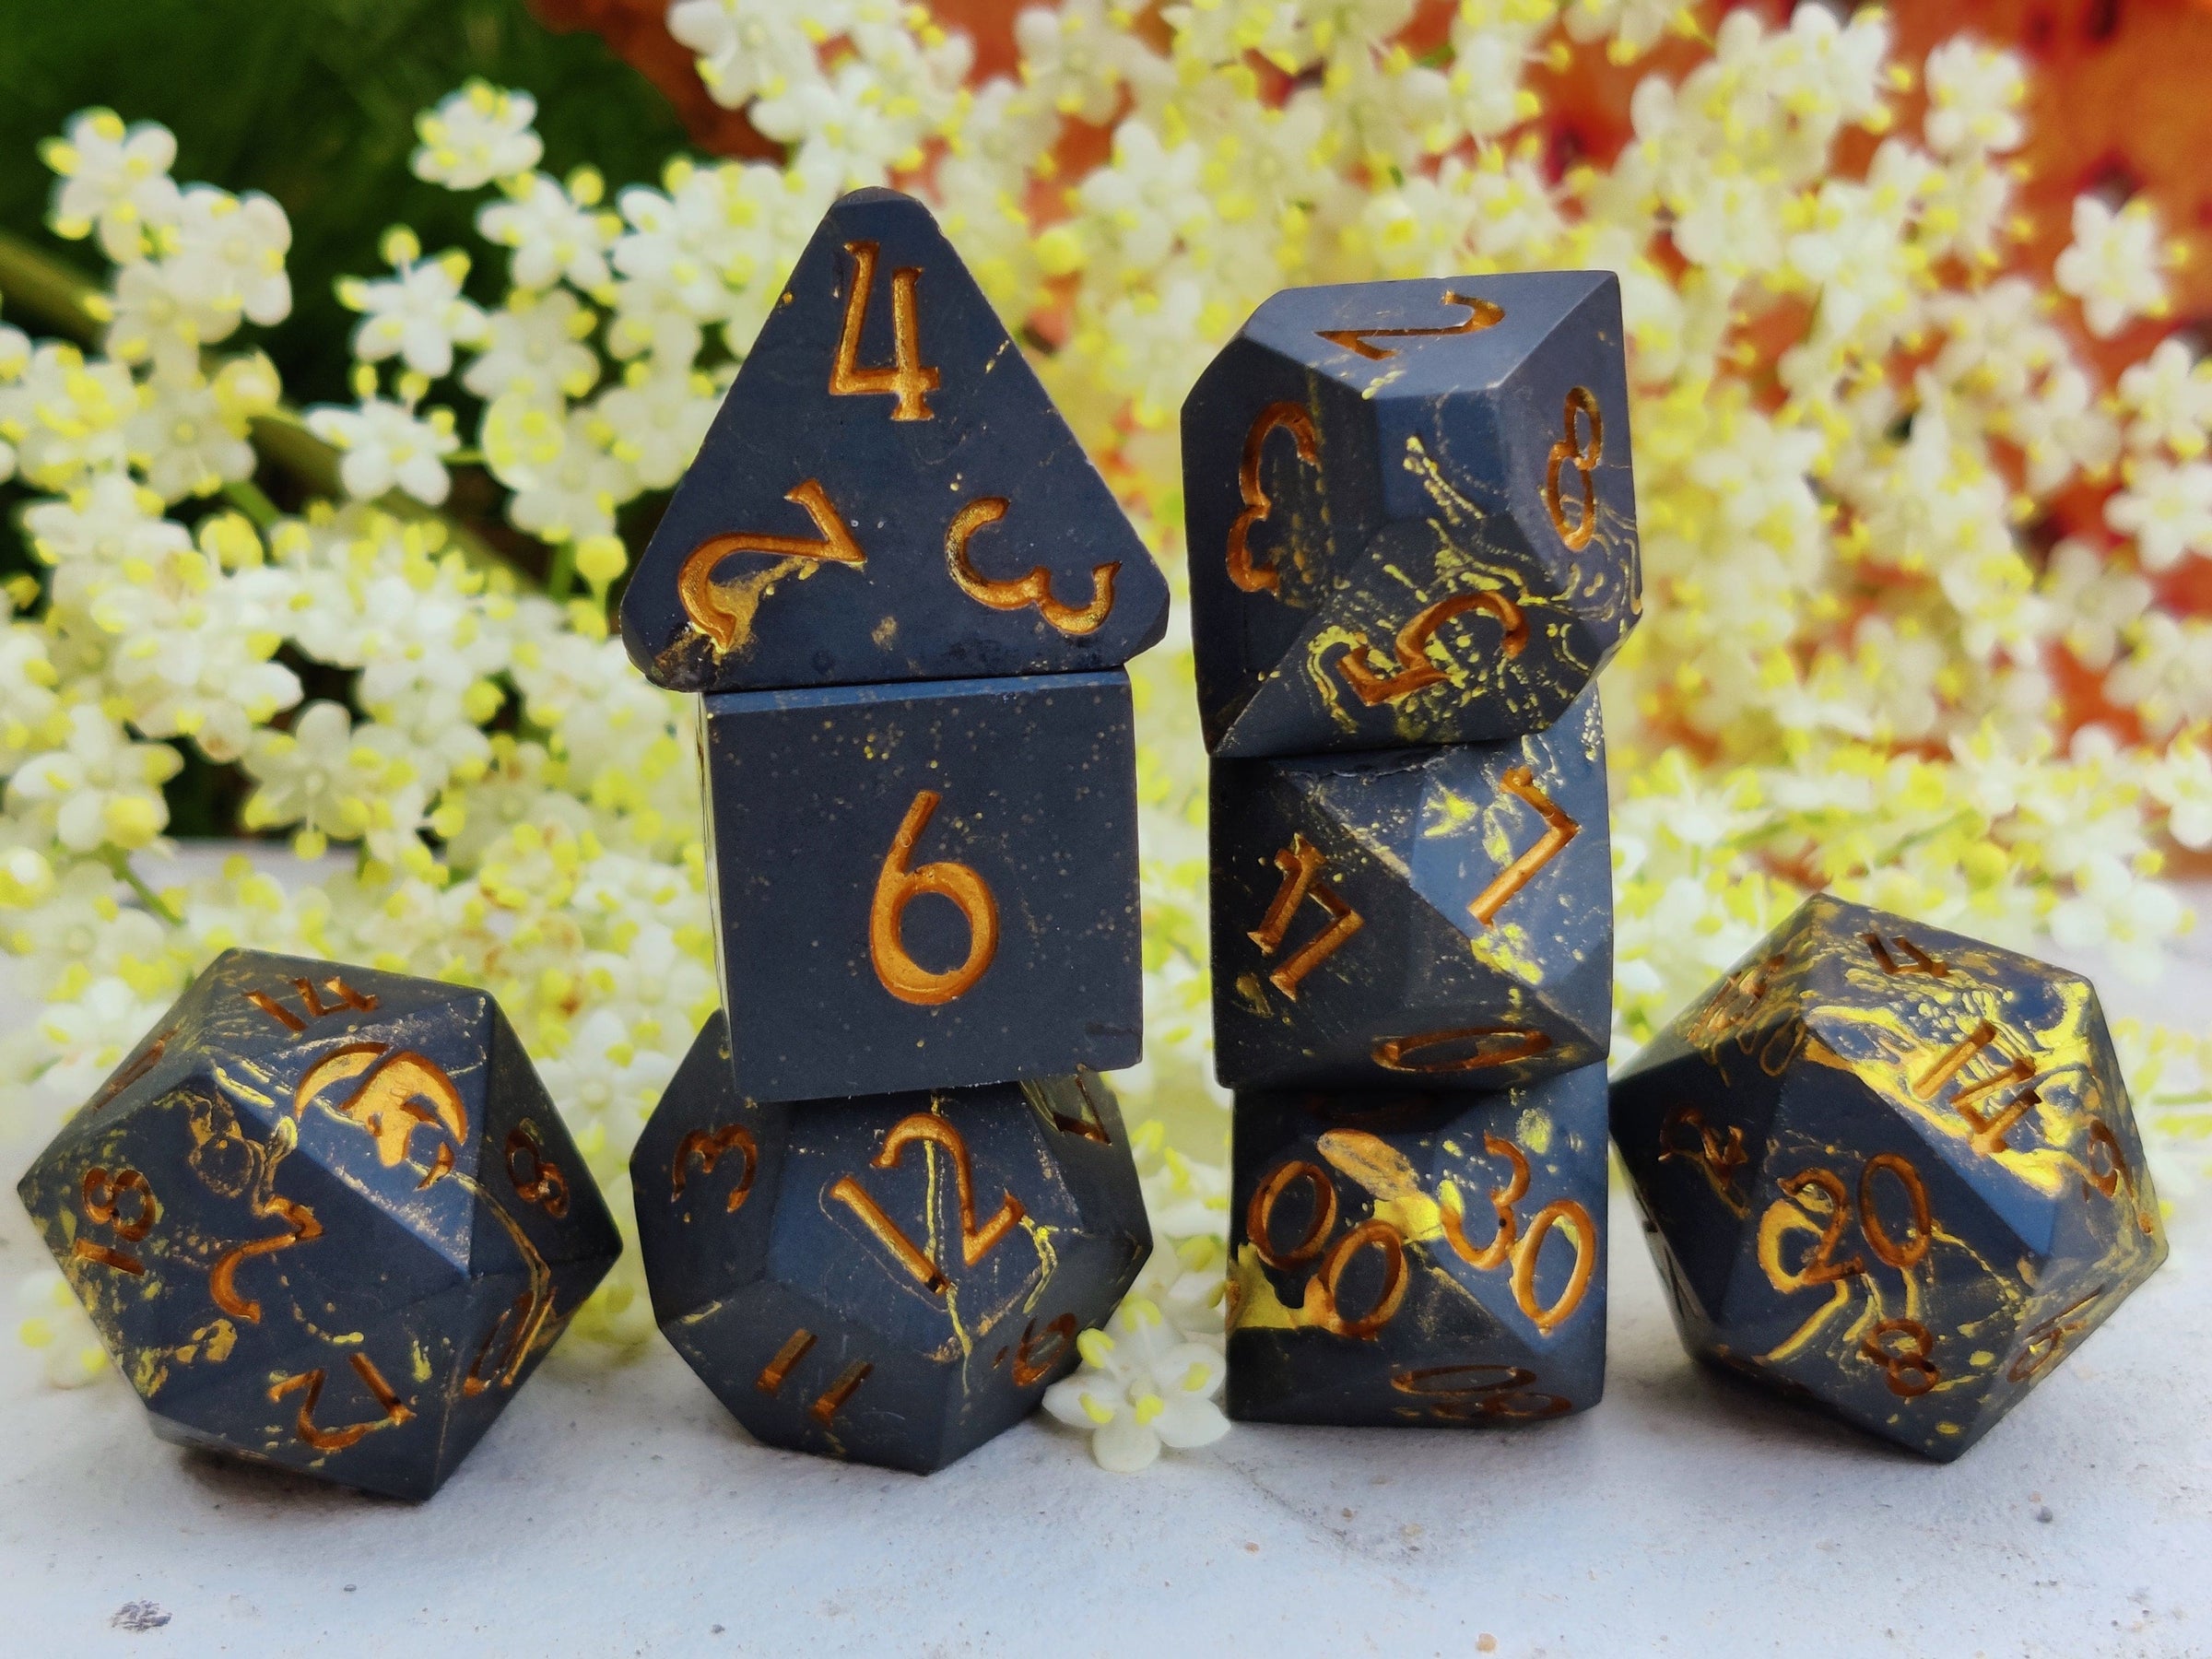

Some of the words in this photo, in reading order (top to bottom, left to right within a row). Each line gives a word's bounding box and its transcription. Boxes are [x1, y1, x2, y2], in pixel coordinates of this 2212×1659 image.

[830, 241, 939, 420] 4
[1314, 289, 1506, 360] 2
[1226, 400, 1322, 595] 3
[1547, 385, 1604, 551] 8
[678, 478, 867, 653] 2
[944, 496, 1122, 634] 3
[1336, 591, 1531, 707] 5
[869, 789, 1000, 1005] 6
[1466, 766, 1583, 930] 7
[243, 975, 379, 1033] 14
[74, 1166, 158, 1277] 18
[505, 1128, 570, 1219] 8
[670, 1124, 758, 1215] 3
[830, 1113, 1028, 1295] 12
[1439, 1131, 1597, 1337] 30
[1776, 1152, 1933, 1285] 20
[209, 1194, 324, 1324] 2
[1245, 1159, 1409, 1341] 00
[267, 1351, 417, 1452] 12
[756, 1327, 875, 1424] 11
[1862, 1317, 1940, 1399] 8
